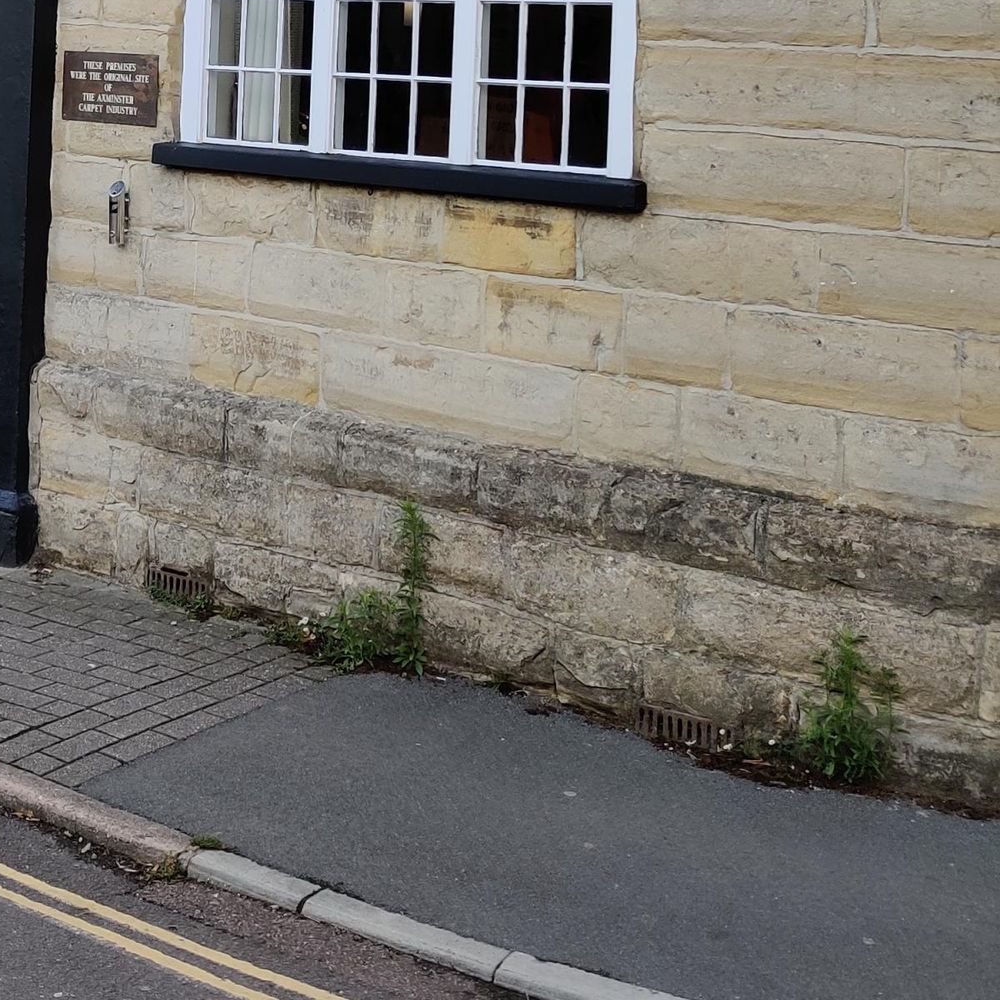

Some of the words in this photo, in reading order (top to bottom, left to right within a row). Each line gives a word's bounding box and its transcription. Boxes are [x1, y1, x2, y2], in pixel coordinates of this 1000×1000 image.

[83, 60, 103, 70] THESE
[105, 61, 137, 72] PREMISES
[70, 70, 87, 80] WERE
[88, 71, 102, 81] THE
[103, 72, 133, 83] ORIGINAL
[134, 74, 150, 84] SITE
[103, 83, 113, 92] OF
[82, 92, 96, 102] THE
[96, 94, 134, 105] AXMINSTER
[78, 103, 104, 113] CARPET
[105, 105, 138, 116] INDUSTRY
